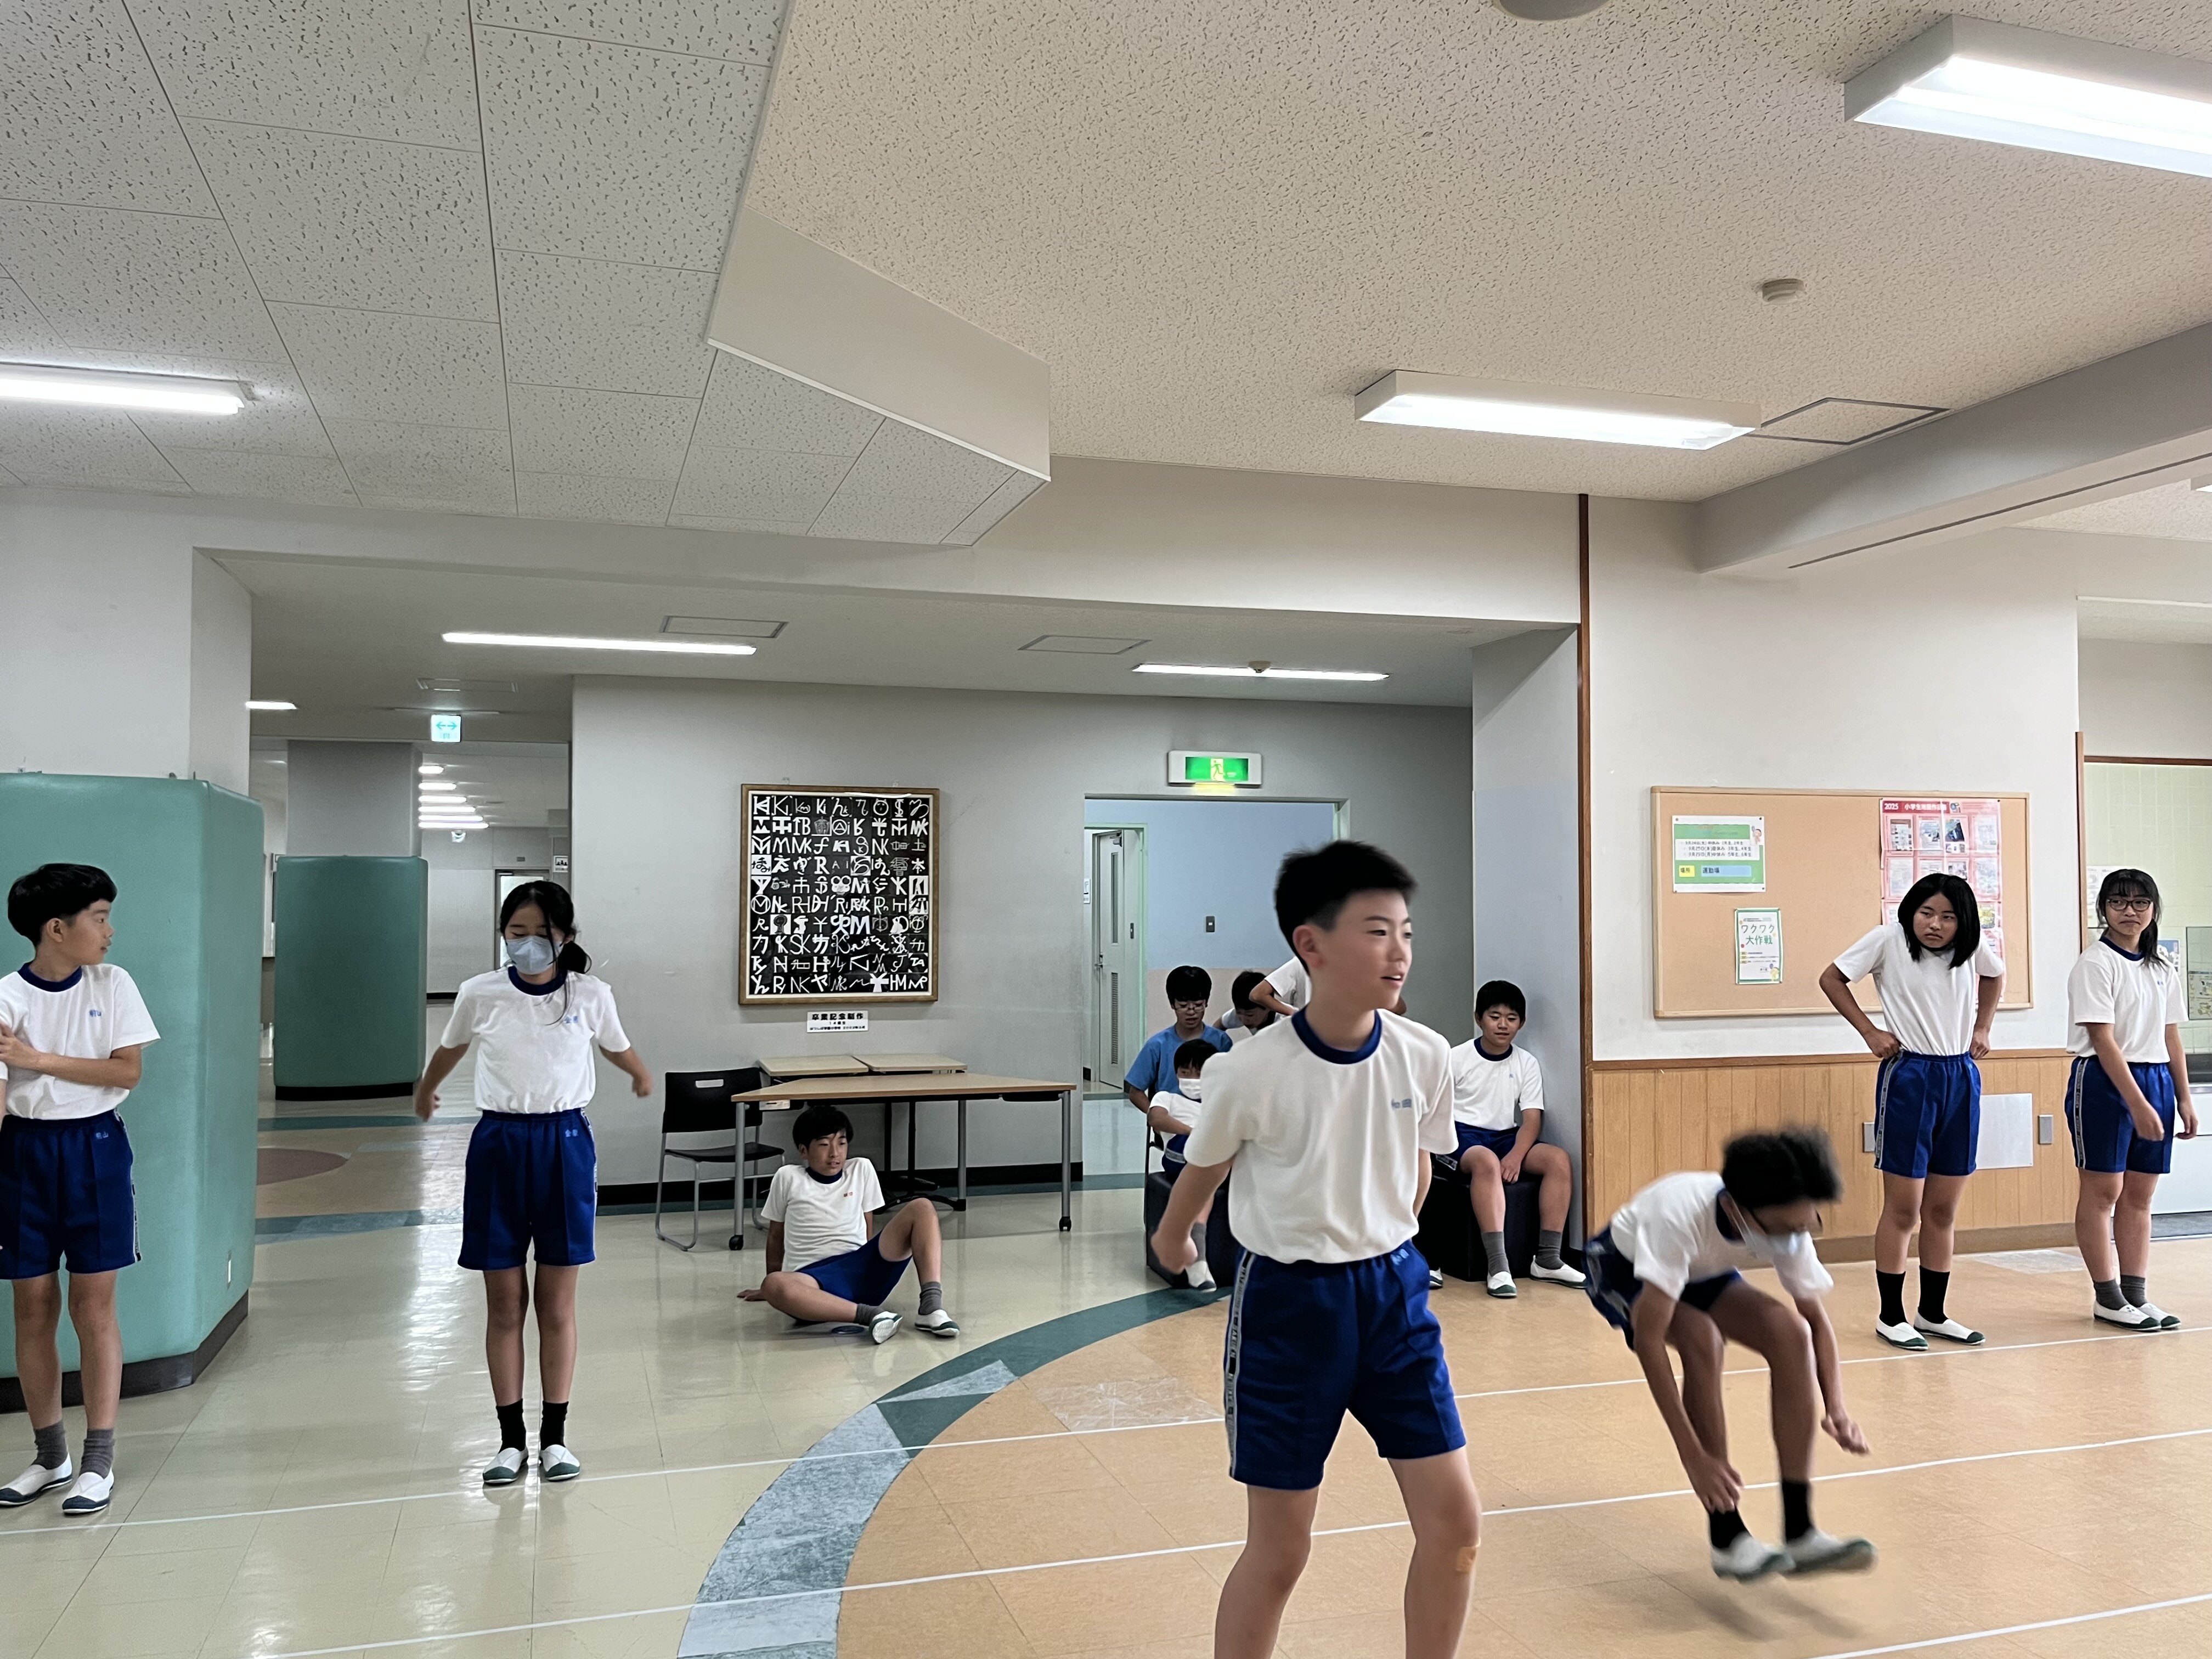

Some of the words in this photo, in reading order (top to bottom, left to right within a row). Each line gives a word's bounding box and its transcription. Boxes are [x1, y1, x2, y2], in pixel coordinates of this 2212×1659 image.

[1741, 924, 1775, 933] ワクワク
[1746, 935, 1773, 945] 大作戦
